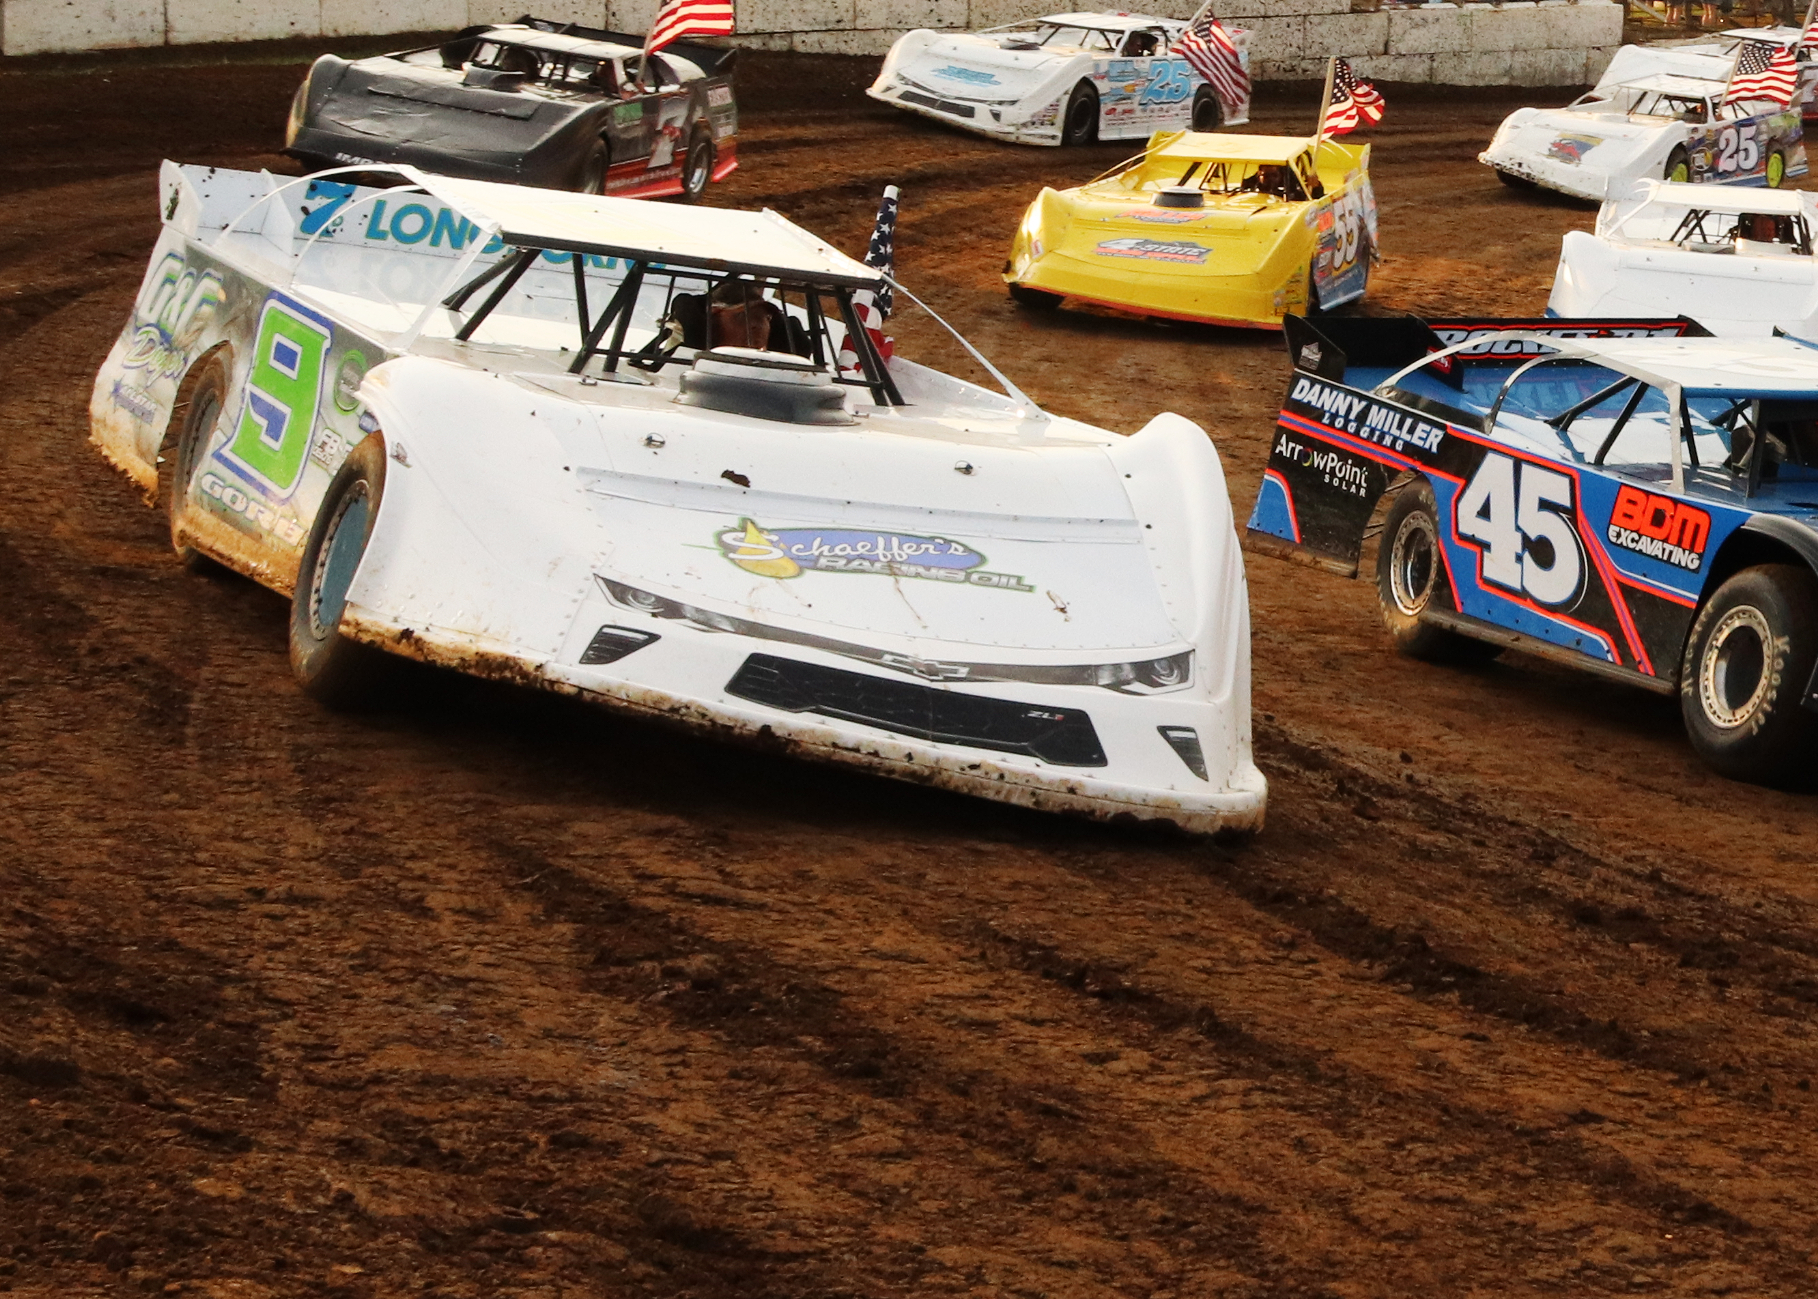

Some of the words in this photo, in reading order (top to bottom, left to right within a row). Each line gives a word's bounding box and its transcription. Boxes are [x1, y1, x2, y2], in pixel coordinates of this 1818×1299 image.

[1141, 59, 1192, 106] 25
[1718, 123, 1759, 172] 25
[214, 292, 333, 504] 9
[1291, 378, 1370, 420] DANNY
[1365, 404, 1447, 454] MILLER
[1321, 412, 1405, 451] LOGGING
[1324, 475, 1366, 498] SOLAR
[1457, 452, 1583, 605] 45
[1610, 483, 1711, 554] BDM
[721, 532, 971, 563] Schaeffer's
[1608, 524, 1700, 570] EXCAVATING
[816, 556, 967, 582] RACING
[969, 571, 1034, 593] OIL
